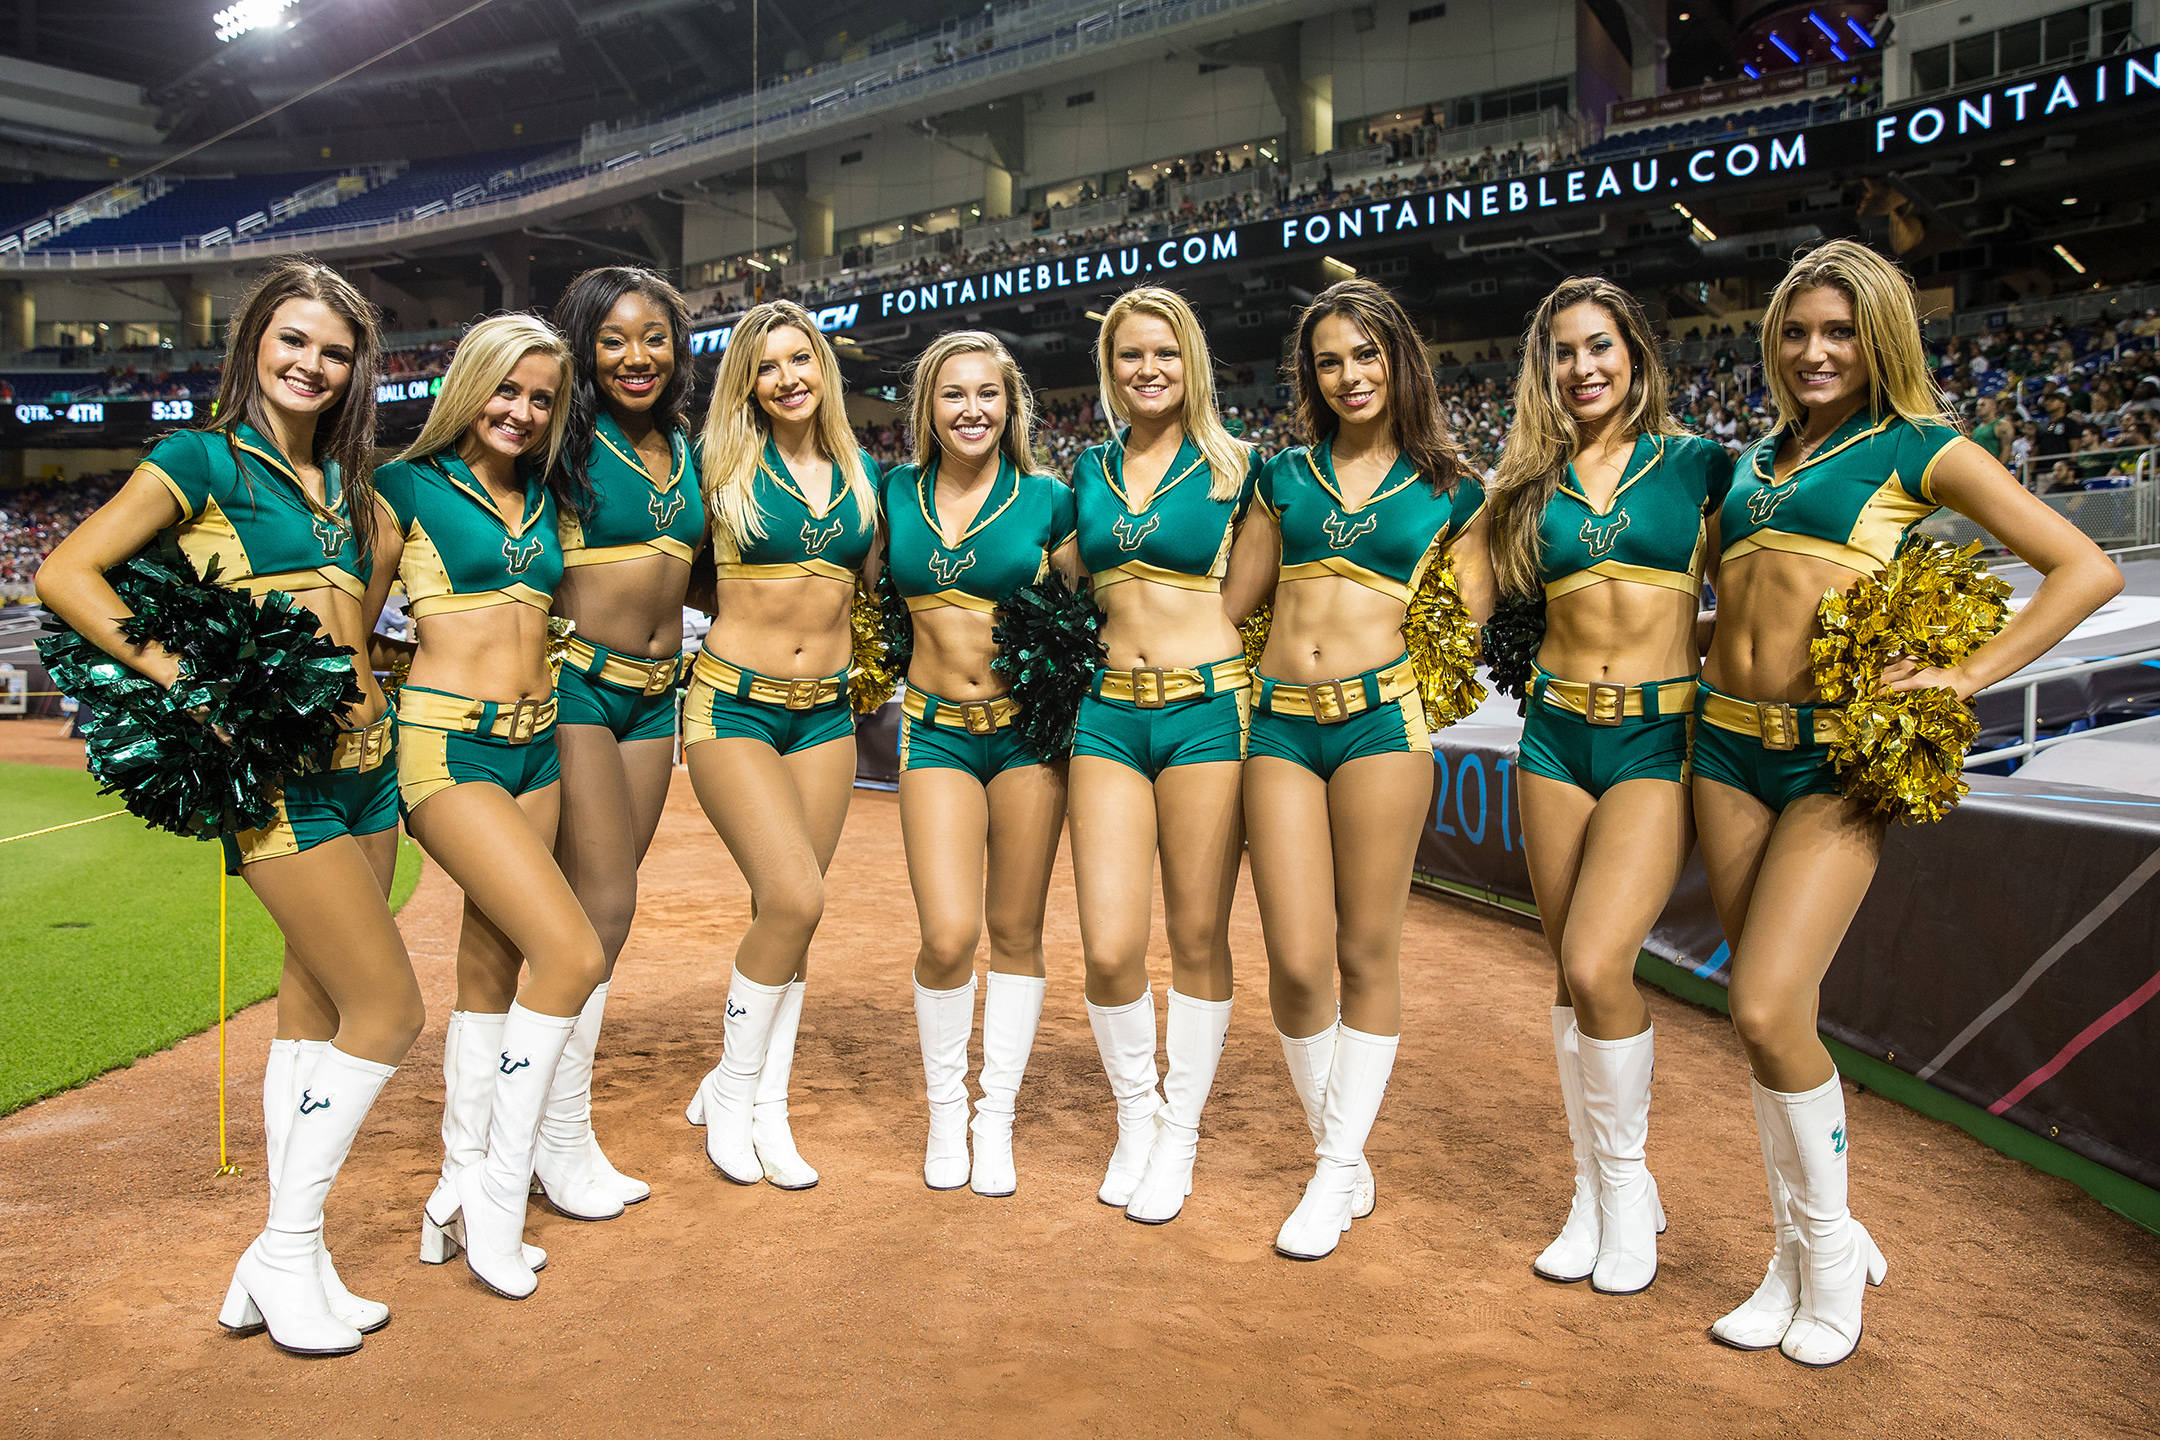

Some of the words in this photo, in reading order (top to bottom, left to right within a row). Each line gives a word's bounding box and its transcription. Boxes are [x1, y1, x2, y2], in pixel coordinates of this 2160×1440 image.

[1282, 133, 1808, 249] FONTAINEBLEAU.COM
[882, 230, 1239, 317] FONTAINEBLEAU.COM
[15, 404, 54, 424] QTR.
[66, 403, 104, 423] 4TH
[151, 400, 194, 421] 5:33
[408, 380, 429, 399] ON
[1433, 749, 1524, 852] 201
